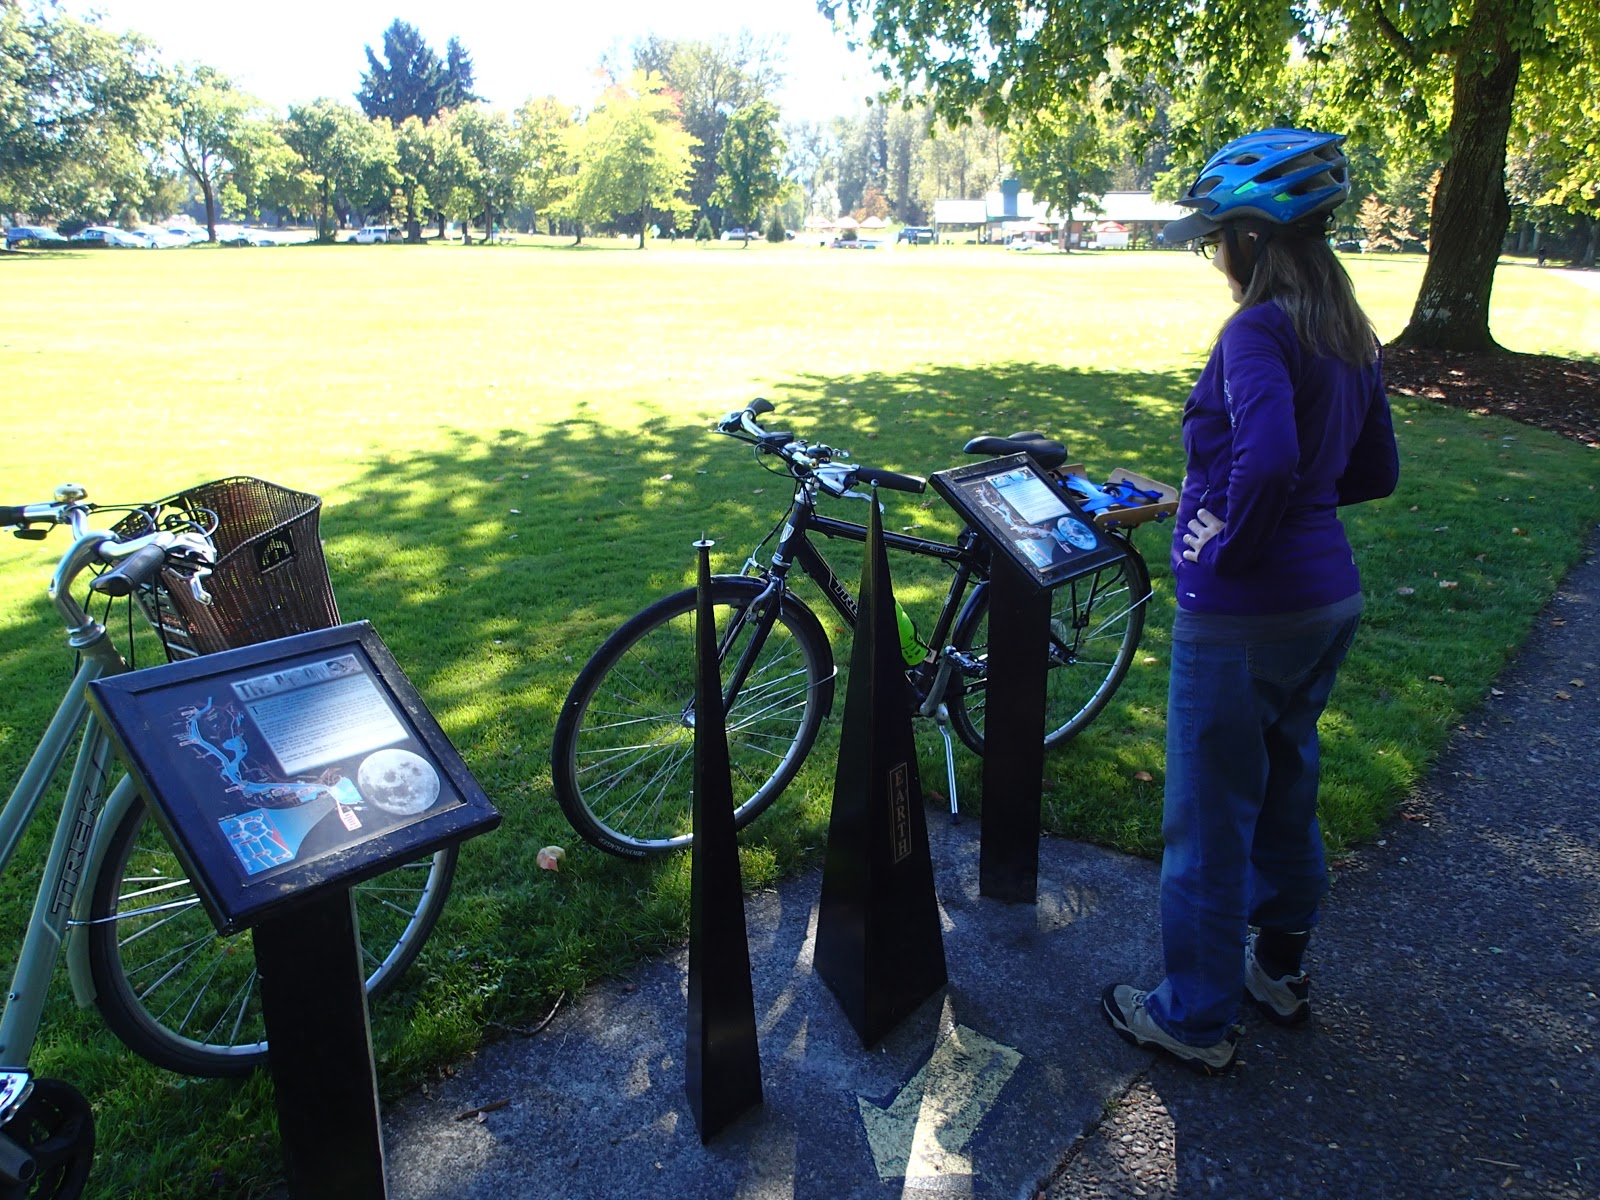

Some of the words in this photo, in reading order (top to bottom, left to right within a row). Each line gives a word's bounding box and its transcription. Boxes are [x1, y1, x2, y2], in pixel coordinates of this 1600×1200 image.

[235, 676, 274, 699] THE
[50, 784, 101, 914] TREK
[895, 769, 908, 857] EARTH
